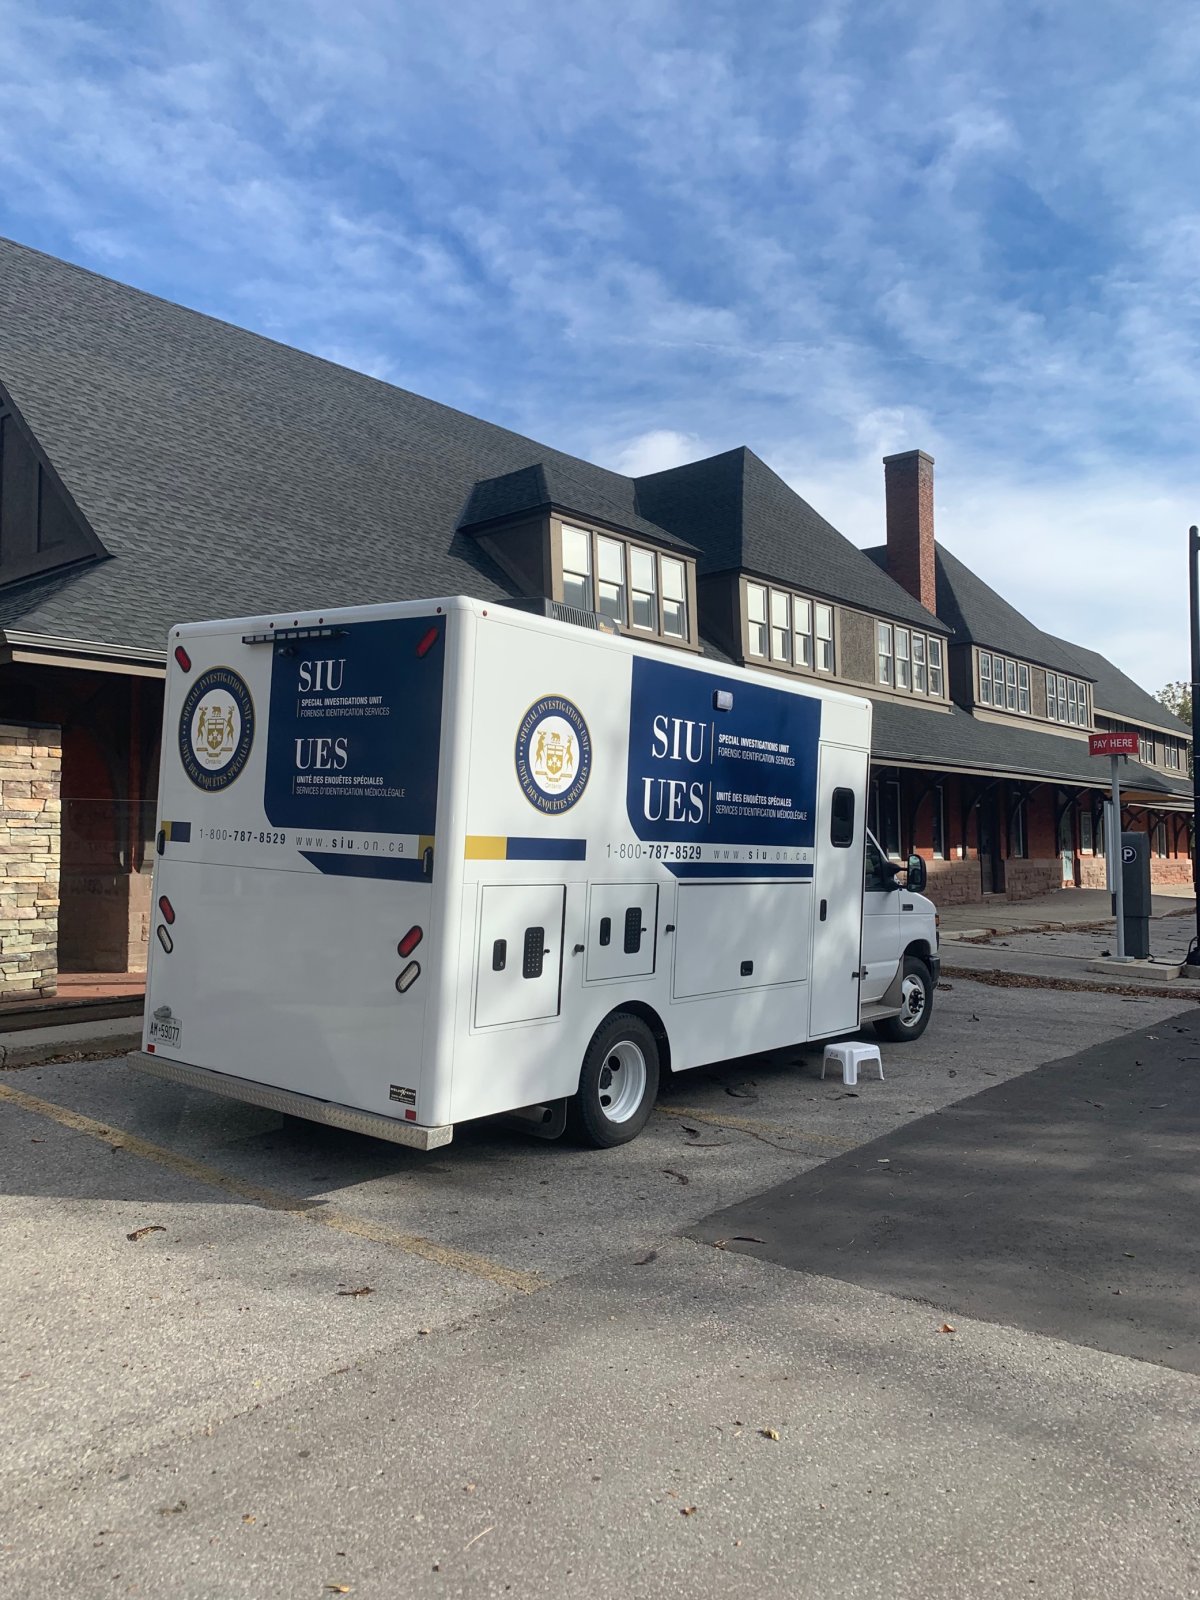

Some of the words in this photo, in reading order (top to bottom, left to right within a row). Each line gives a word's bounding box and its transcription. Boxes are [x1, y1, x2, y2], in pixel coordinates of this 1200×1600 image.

[298, 659, 346, 692] SIU
[184, 689, 200, 721] SPECIAL
[200, 673, 244, 698] INVESTIGATIONS
[242, 697, 252, 720] UNIT
[302, 698, 323, 706] SPECIAL
[324, 696, 368, 706] INVESTIGATIONS
[369, 696, 382, 704] UNIT
[301, 709, 324, 717] FORENSIC
[326, 708, 363, 717] IDENTIFICATION
[364, 707, 390, 716] SERVICES
[520, 711, 538, 743] SPECIAL
[538, 700, 582, 729] INVESTIGATIONS
[581, 727, 590, 751] UNIT
[651, 714, 707, 763] SIU
[719, 734, 739, 746] SPECIAL
[741, 737, 778, 752] INVESTIGATIONS
[779, 744, 789, 754] UNIT
[1093, 740, 1107, 749] PAY
[1110, 738, 1132, 748] HERE
[294, 738, 348, 769] UES
[718, 747, 741, 759] FORENSIC
[742, 750, 774, 764] IDENTIFICATION
[775, 756, 795, 766] SERVICES
[296, 774, 312, 784] UNITÉ
[313, 776, 324, 784] DES
[325, 775, 352, 785] ENQUÊTES
[353, 775, 383, 785] SPÉCIALES
[518, 760, 530, 787] UNITÉ
[527, 786, 538, 802] DES
[537, 798, 567, 811] ENQUÊTES
[567, 766, 588, 804] SPÉCIALES
[296, 786, 319, 795] SERVICES
[320, 787, 363, 796] D'IDENTIFICATION
[364, 787, 405, 797] MÉDICOLÉGALE
[641, 777, 704, 824] UES
[716, 791, 731, 801] UNITÉ
[732, 793, 742, 803] DES
[743, 794, 767, 805] ENQUÊTES
[768, 796, 792, 807] SPÉCIALES
[716, 804, 738, 815] SERVICES
[739, 807, 776, 818] D'IDENTIFICATION
[777, 809, 808, 821] MÉDICOLÉGALE
[199, 828, 286, 845] 1-800-787-8529
[296, 835, 404, 853] www.siu.on.ca
[606, 843, 702, 860] 1-800-787-8529
[714, 849, 807, 861] www.siu.on.ca
[1124, 850, 1132, 861] P
